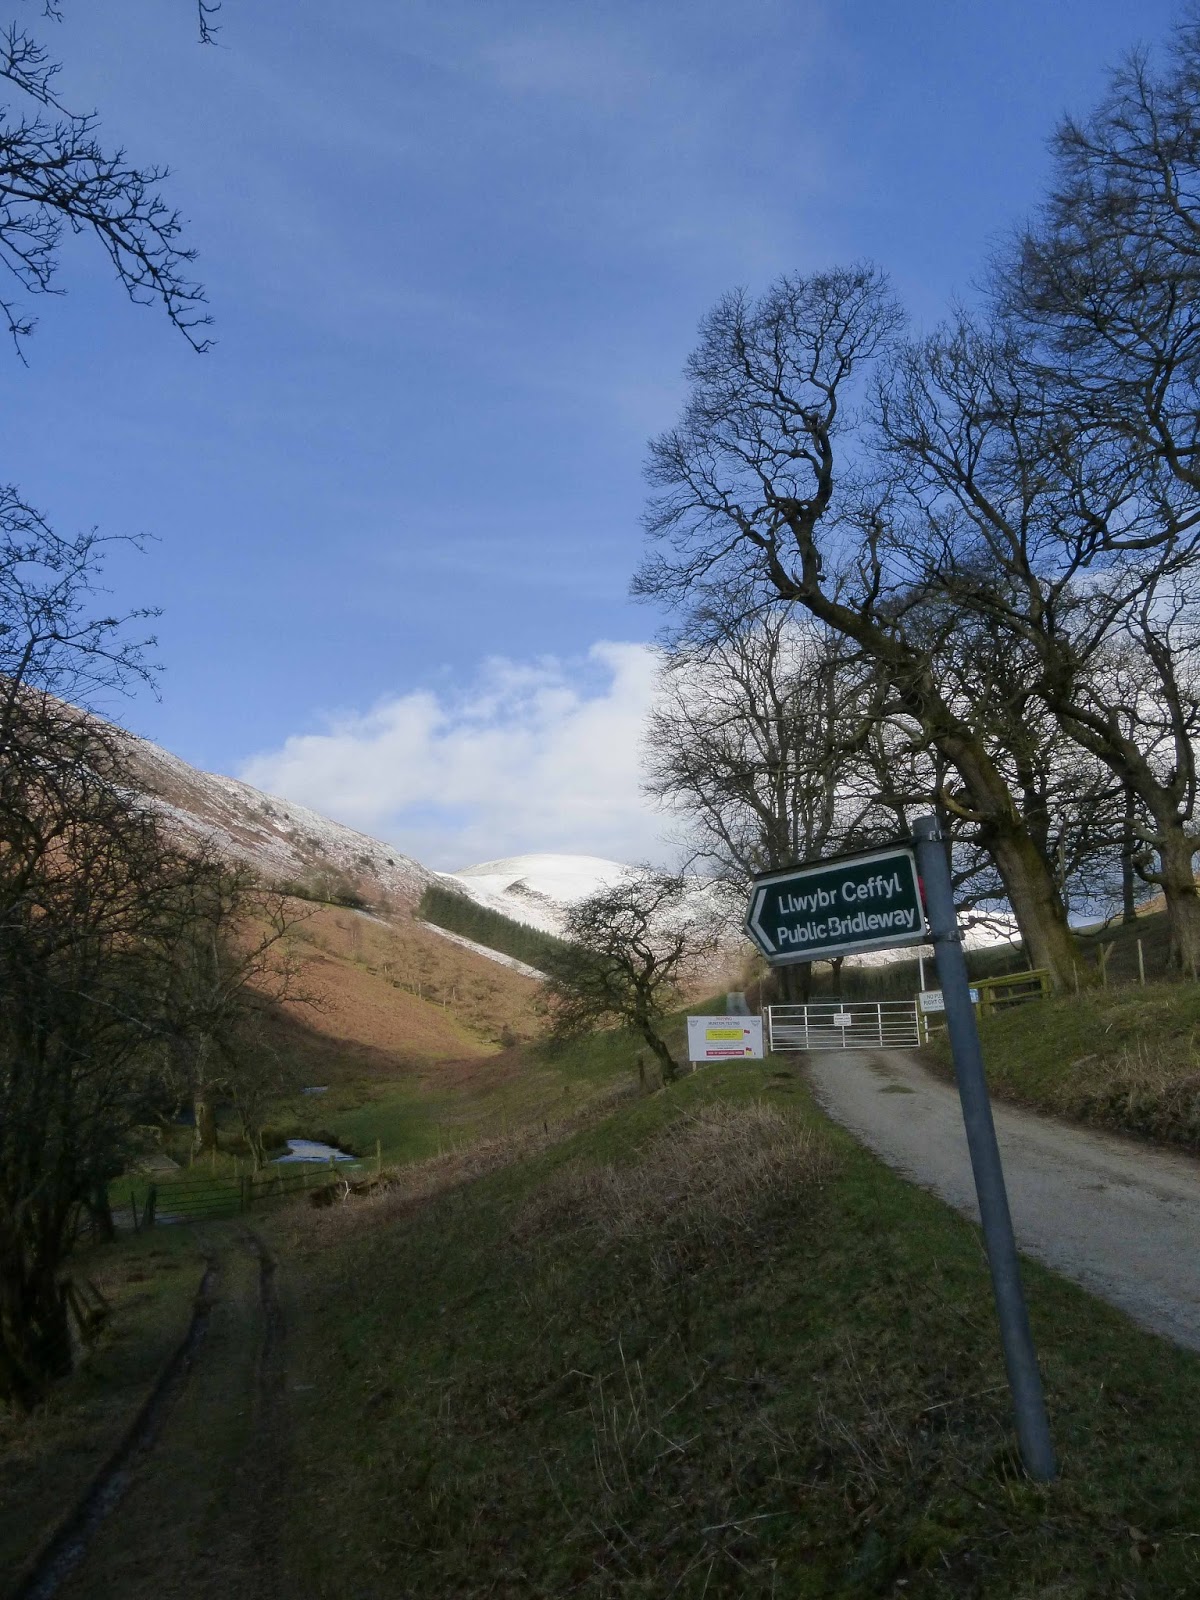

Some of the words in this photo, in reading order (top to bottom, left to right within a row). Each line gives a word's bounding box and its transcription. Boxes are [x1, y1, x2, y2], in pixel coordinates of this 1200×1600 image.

[778, 888, 837, 914] Llwybr
[841, 872, 902, 902] Ceffyl
[777, 923, 828, 945] Public
[828, 908, 915, 937] Bridleway
